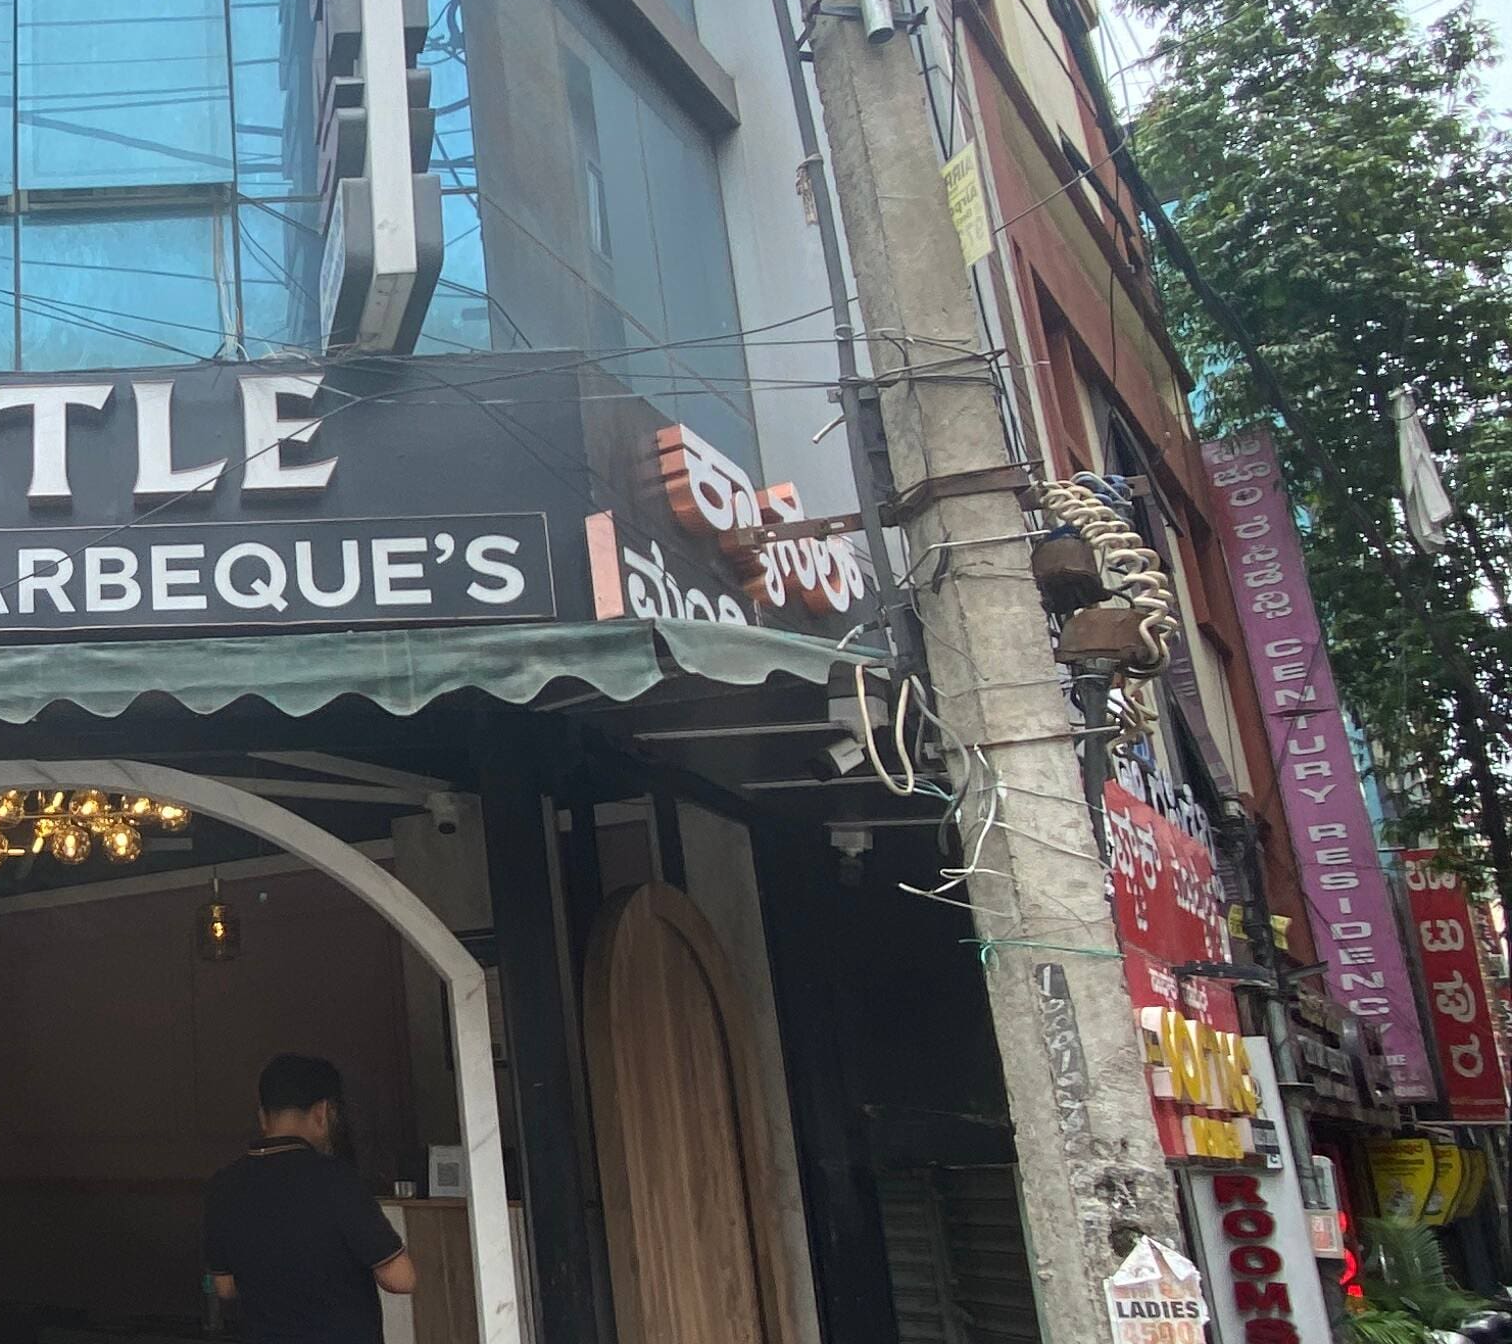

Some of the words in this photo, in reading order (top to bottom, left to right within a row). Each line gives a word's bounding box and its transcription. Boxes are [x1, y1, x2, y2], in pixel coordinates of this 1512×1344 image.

[1264, 638, 1337, 804] CENTURY
[1307, 822, 1393, 1035] RESIDENC
[1116, 1301, 1200, 1319] LADIES
